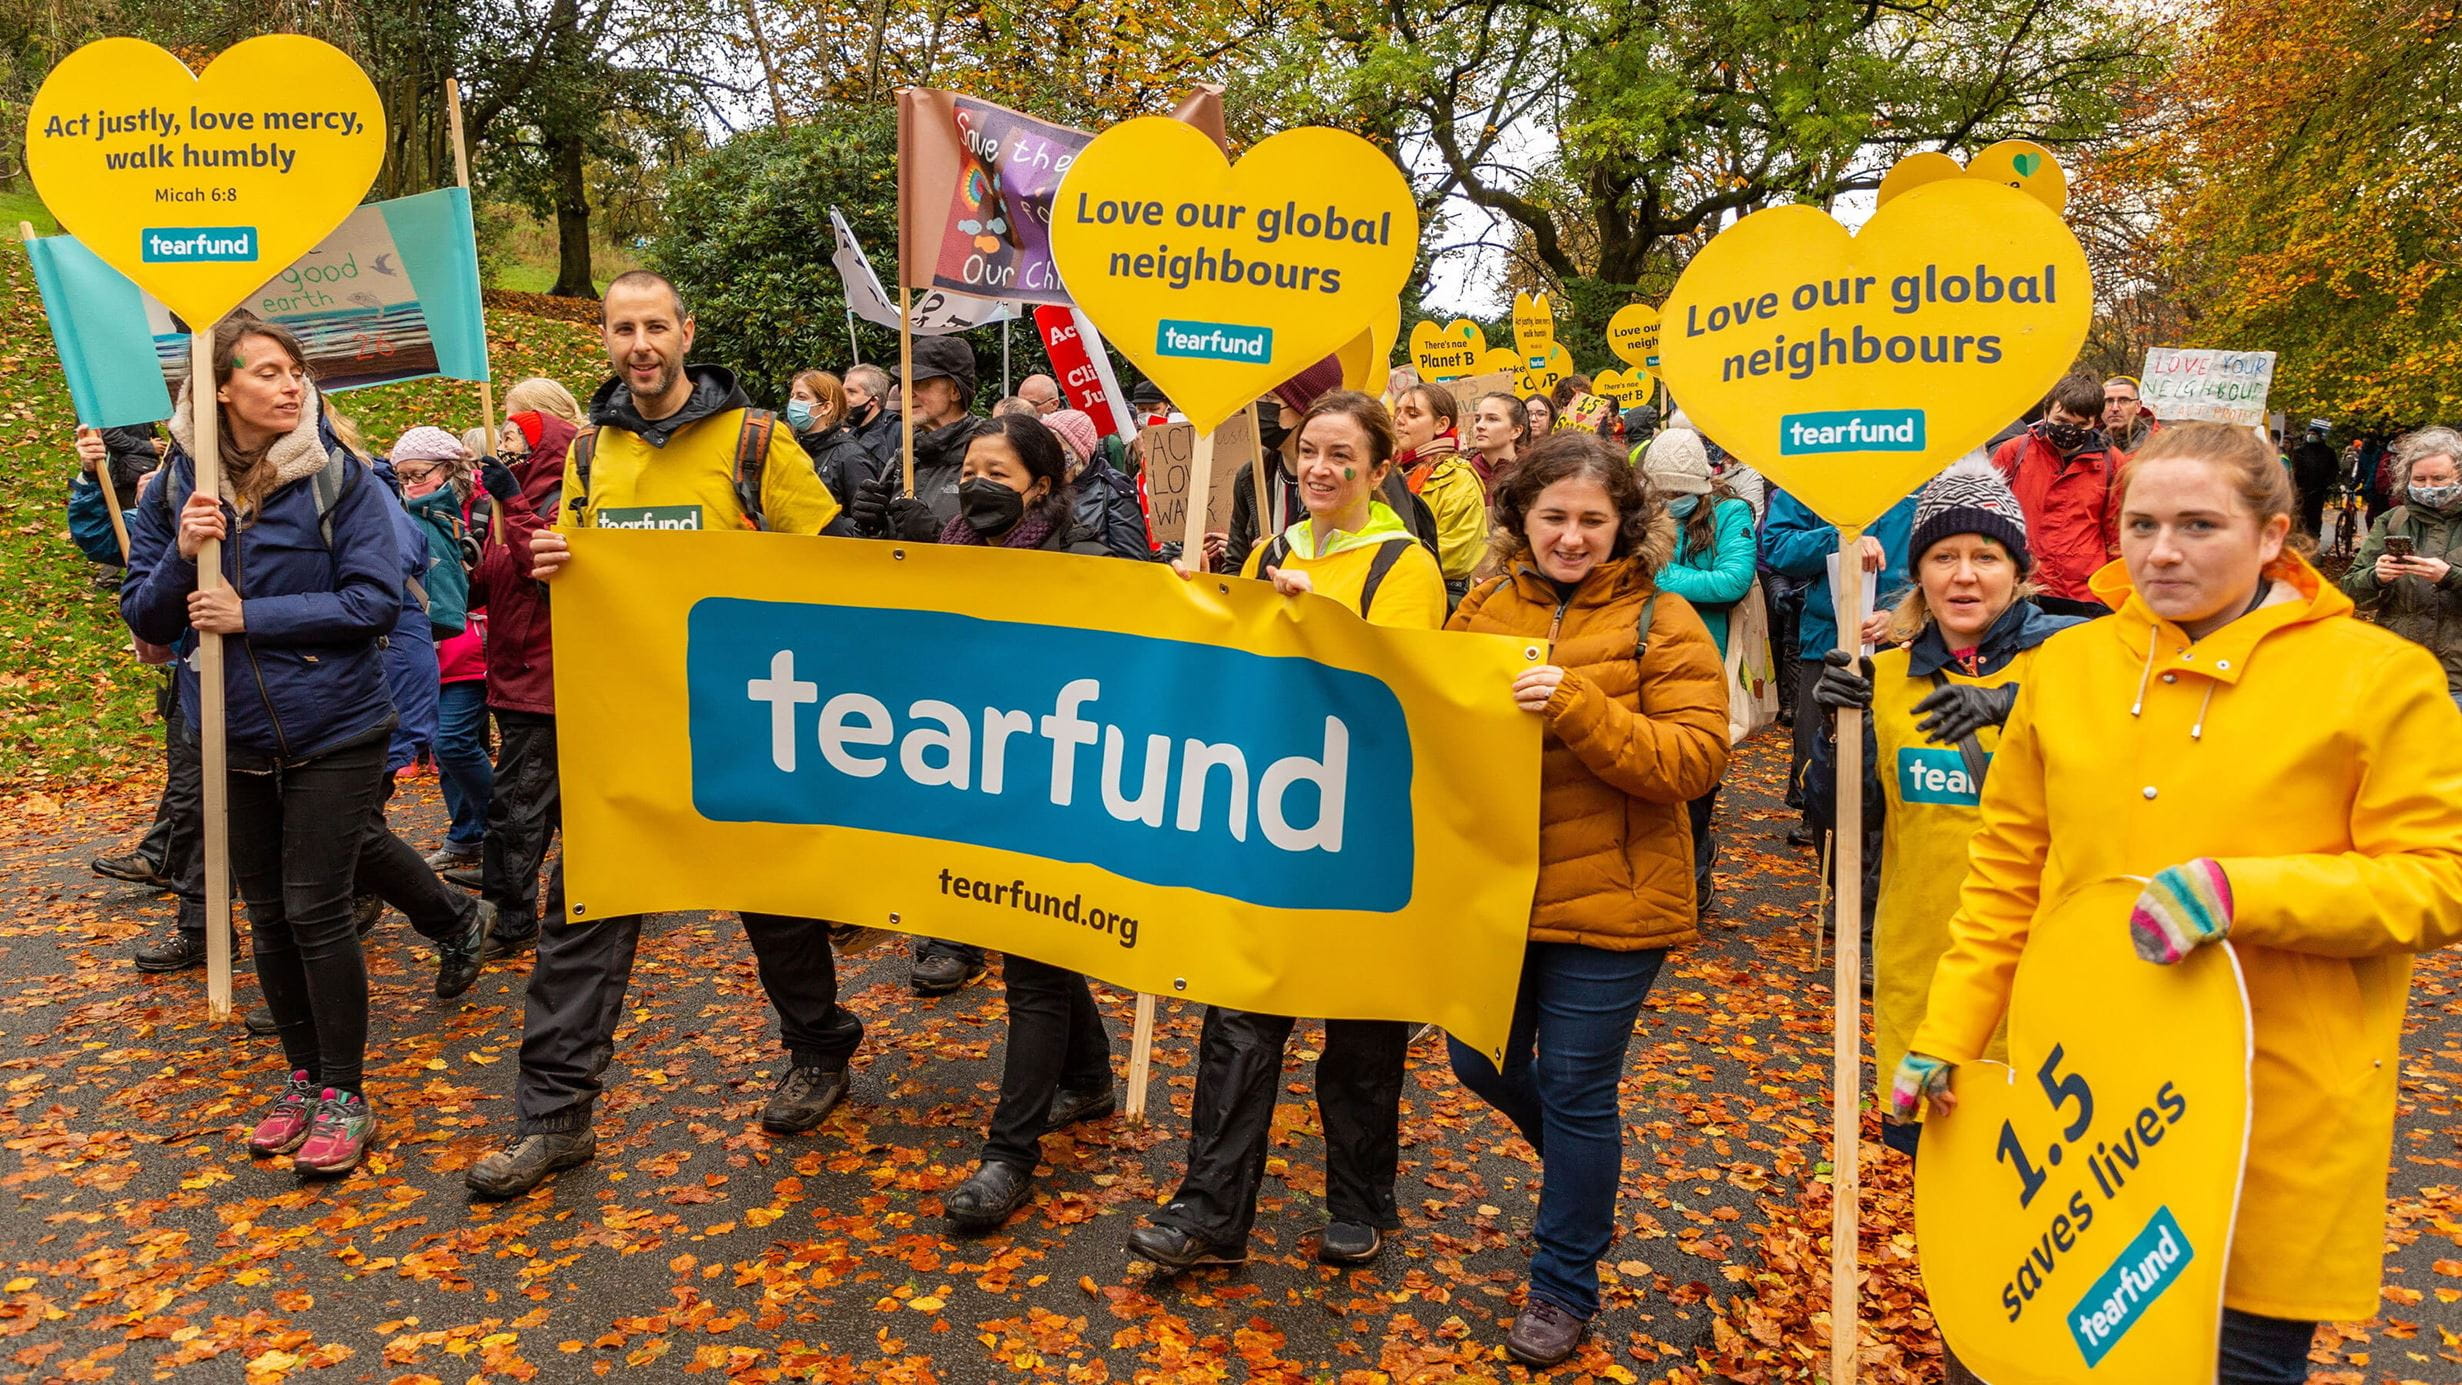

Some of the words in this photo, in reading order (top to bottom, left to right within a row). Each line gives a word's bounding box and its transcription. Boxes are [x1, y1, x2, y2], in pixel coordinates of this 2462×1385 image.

[44, 113, 90, 138] Act
[95, 106, 182, 142] justly,
[190, 105, 254, 130] love
[263, 110, 365, 136] mercy,
[105, 143, 174, 170] walk
[183, 143, 297, 174] humbly
[956, 112, 999, 163] Save
[1012, 140, 1073, 173] the
[155, 188, 205, 202] Micah
[211, 188, 238, 202] 6:8
[1077, 192, 1164, 226] Love
[1176, 202, 1246, 230] our
[1257, 201, 1391, 246] global
[149, 233, 249, 256] tearfund
[280, 252, 359, 292] good
[963, 254, 1015, 287] Our
[1109, 244, 1341, 294] neighbours
[263, 290, 335, 313] earth
[1686, 292, 1778, 338] Love
[1791, 273, 1876, 312] our
[1891, 264, 2056, 314] global
[353, 332, 396, 361] 26
[1165, 326, 1263, 357] tearfund
[1424, 340, 1451, 350] There's
[1452, 341, 1467, 349] nae
[1614, 326, 1641, 338] Love
[1420, 352, 1461, 369] Planet
[1463, 351, 1475, 366] B
[1722, 325, 2003, 382] neighbours
[2154, 355, 2210, 376] LOVE
[2223, 355, 2268, 377] YOUR
[1635, 389, 1644, 400] B
[1790, 417, 1914, 446] tearfund
[747, 649, 1350, 853] tearfund
[938, 867, 1140, 949] tearfund.org
[1996, 1042, 2094, 1210] 1.5
[2001, 1190, 2094, 1323] saves
[2087, 1080, 2186, 1200] lives
[2079, 1224, 2181, 1347] tearfund
